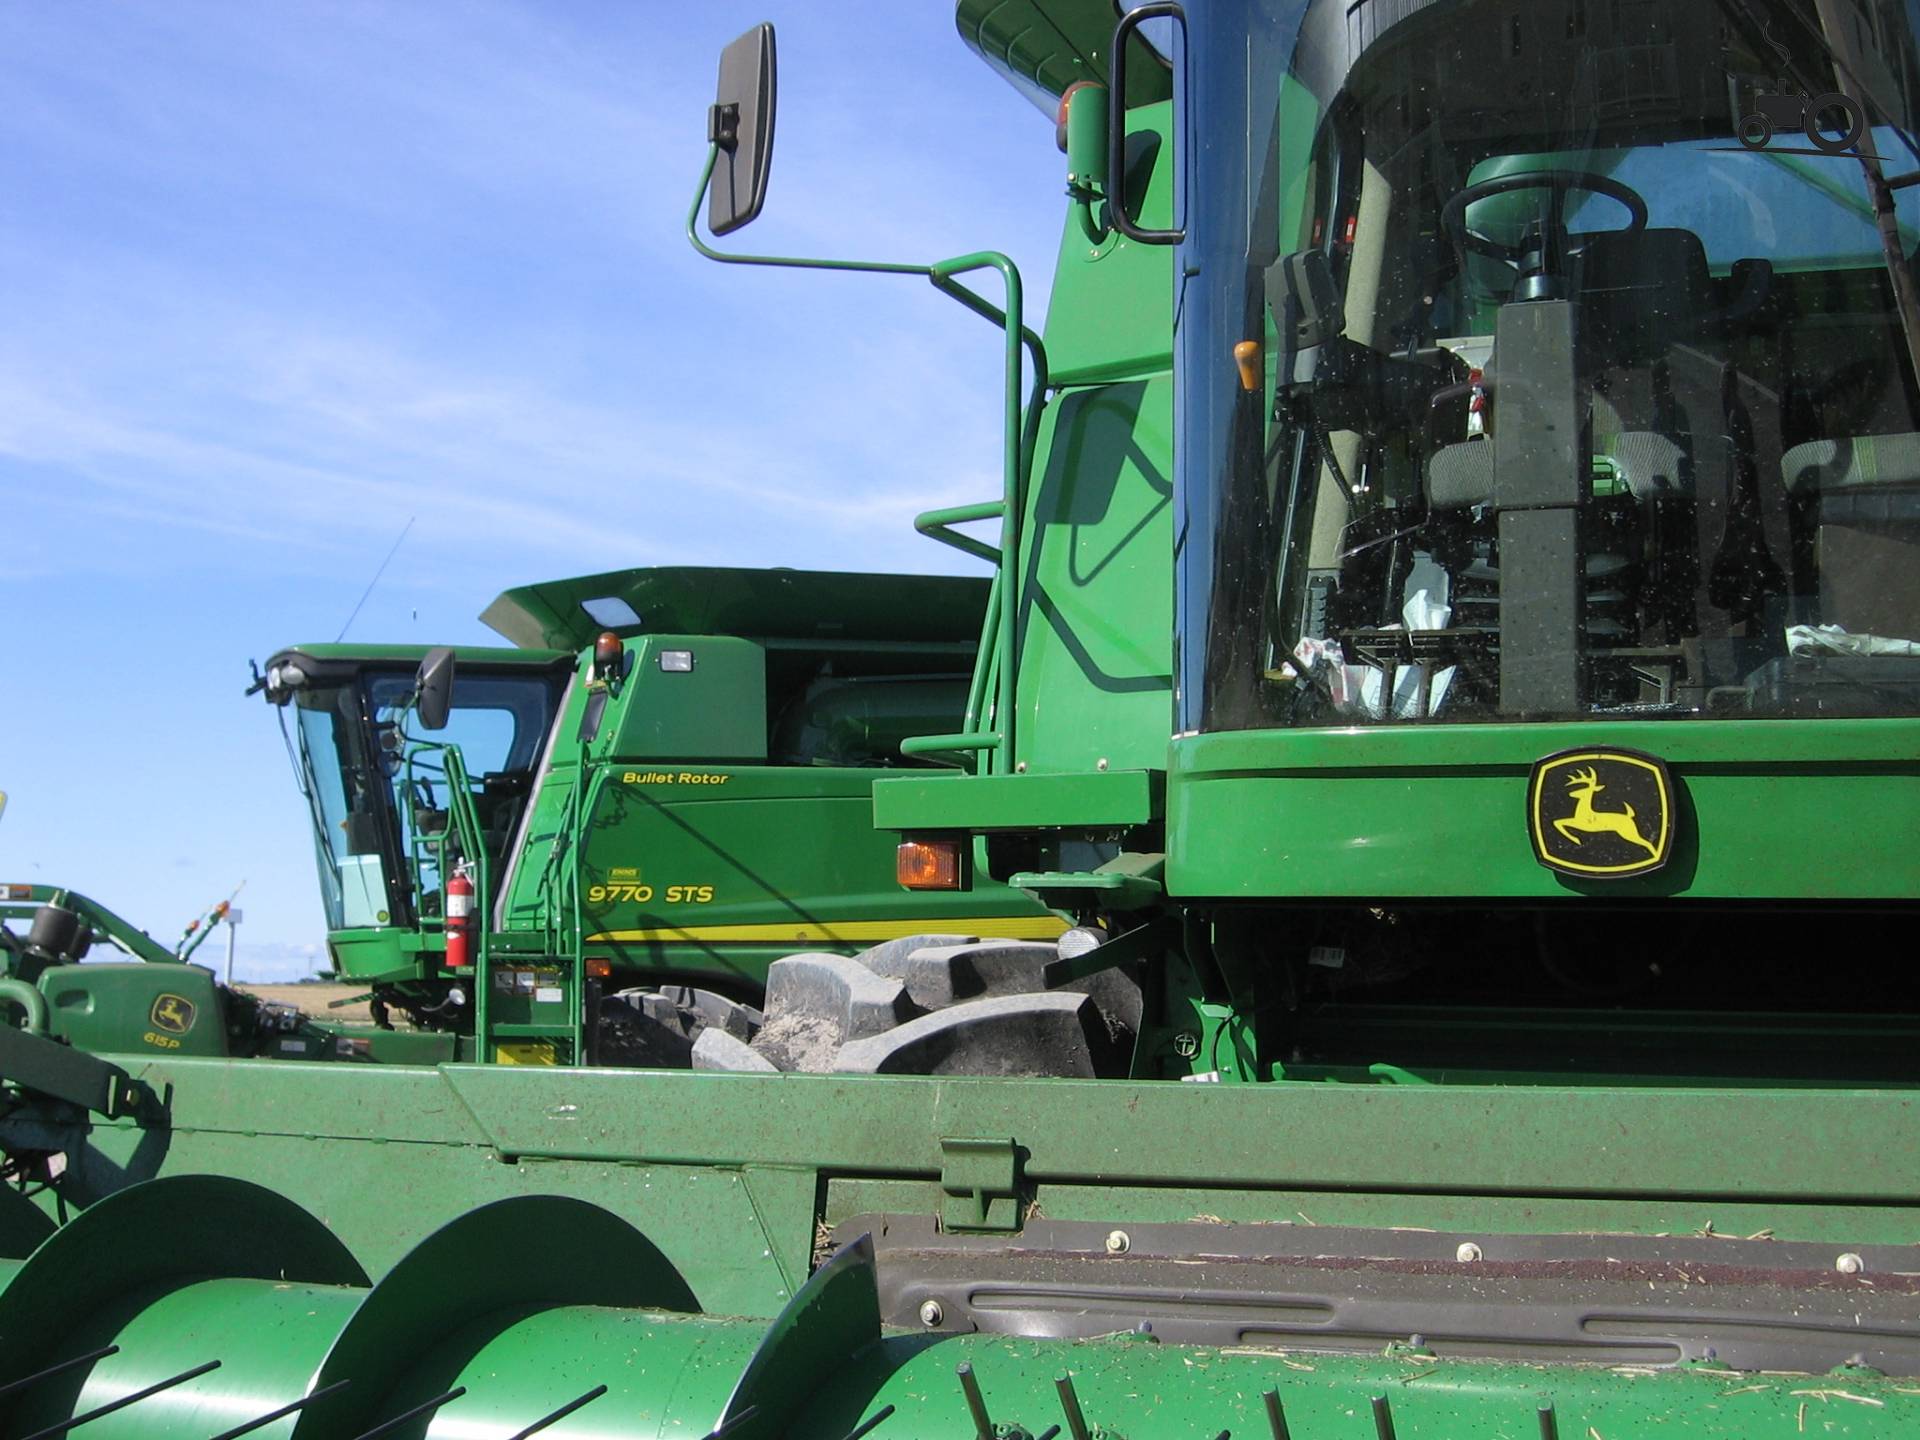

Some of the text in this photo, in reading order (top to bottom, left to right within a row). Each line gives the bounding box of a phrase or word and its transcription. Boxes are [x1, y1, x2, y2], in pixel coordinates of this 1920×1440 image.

[622, 772, 728, 784] Bullet Rotor
[588, 886, 714, 902] 9770 STS
[143, 1032, 180, 1049] 615P
